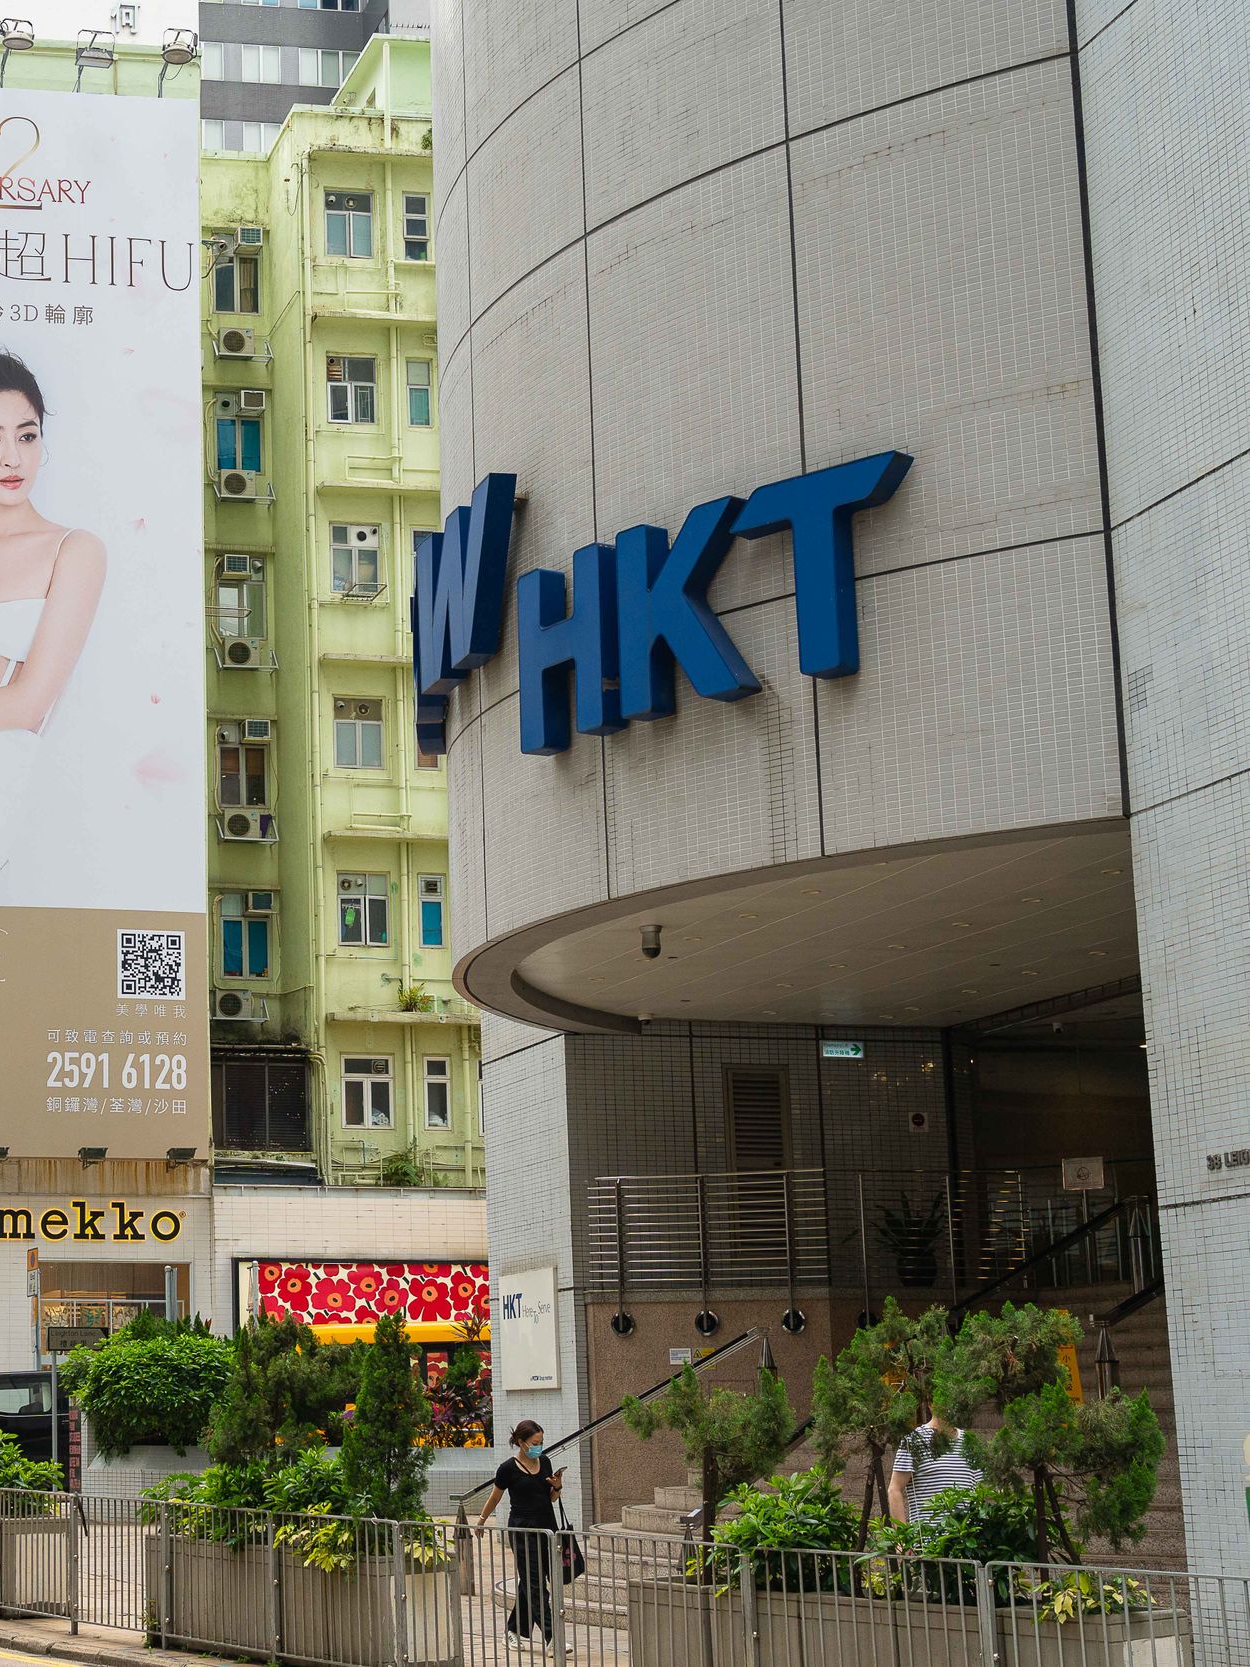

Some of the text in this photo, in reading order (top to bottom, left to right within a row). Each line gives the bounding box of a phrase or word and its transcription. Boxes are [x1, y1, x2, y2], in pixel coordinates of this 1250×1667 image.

[518, 450, 914, 756] HKT
[116, 1003, 187, 1019] 美學唯我
[47, 1029, 188, 1047] 可致電查詢或預約
[47, 1052, 188, 1091] 2591 6128
[46, 1096, 188, 1116] 銅鑼灣/荃灣/沙田
[503, 1293, 522, 1319] HKT
[538, 1301, 550, 1314] Serve
